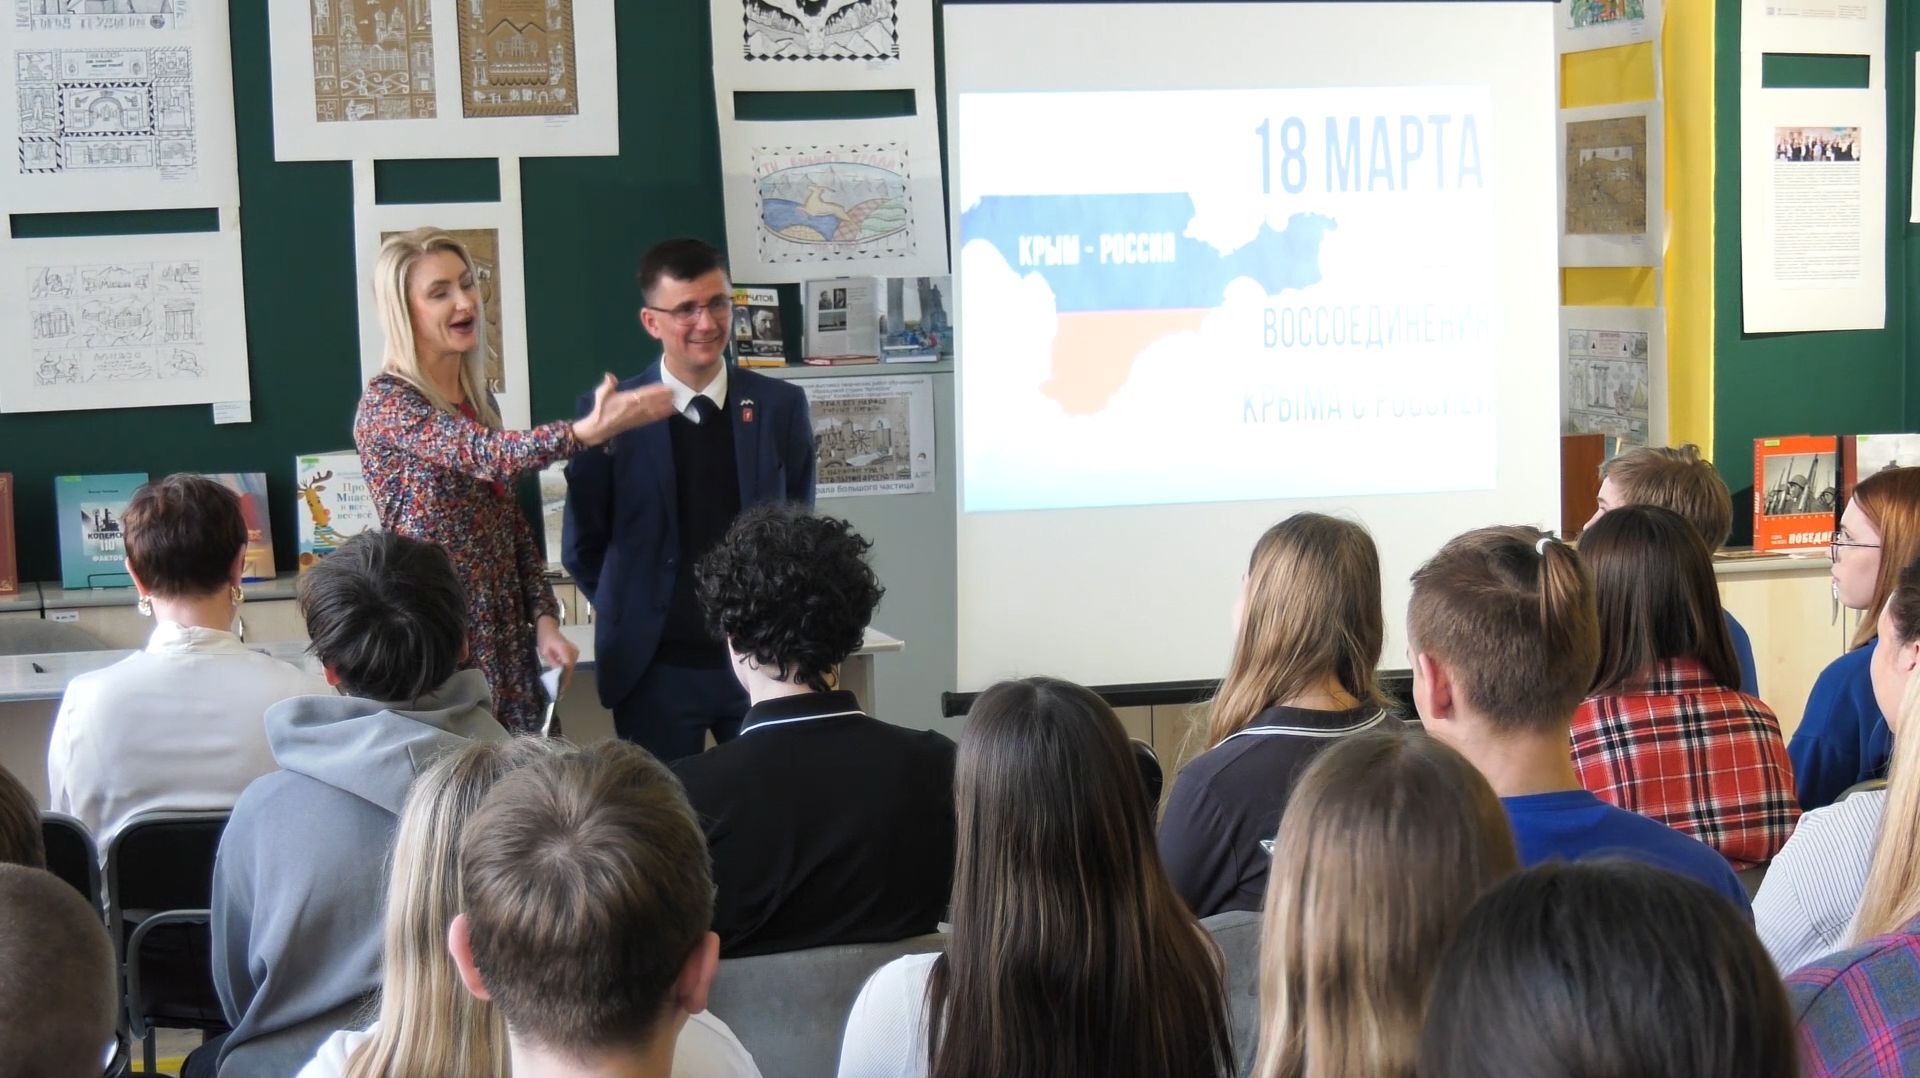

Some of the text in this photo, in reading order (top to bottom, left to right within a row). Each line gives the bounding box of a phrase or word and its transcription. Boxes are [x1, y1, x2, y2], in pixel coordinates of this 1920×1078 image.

[1255, 114, 1484, 195] 18 МАРТА
[1018, 235, 1080, 266] КРЫМ
[1100, 232, 1176, 264] РОССИЯ
[1263, 303, 1490, 350] ВОССОЕДИНЕНИЯ
[1242, 383, 1343, 424] КРЫМА
[344, 482, 365, 493] Про
[837, 484, 878, 493] большого
[101, 540, 115, 550] 110
